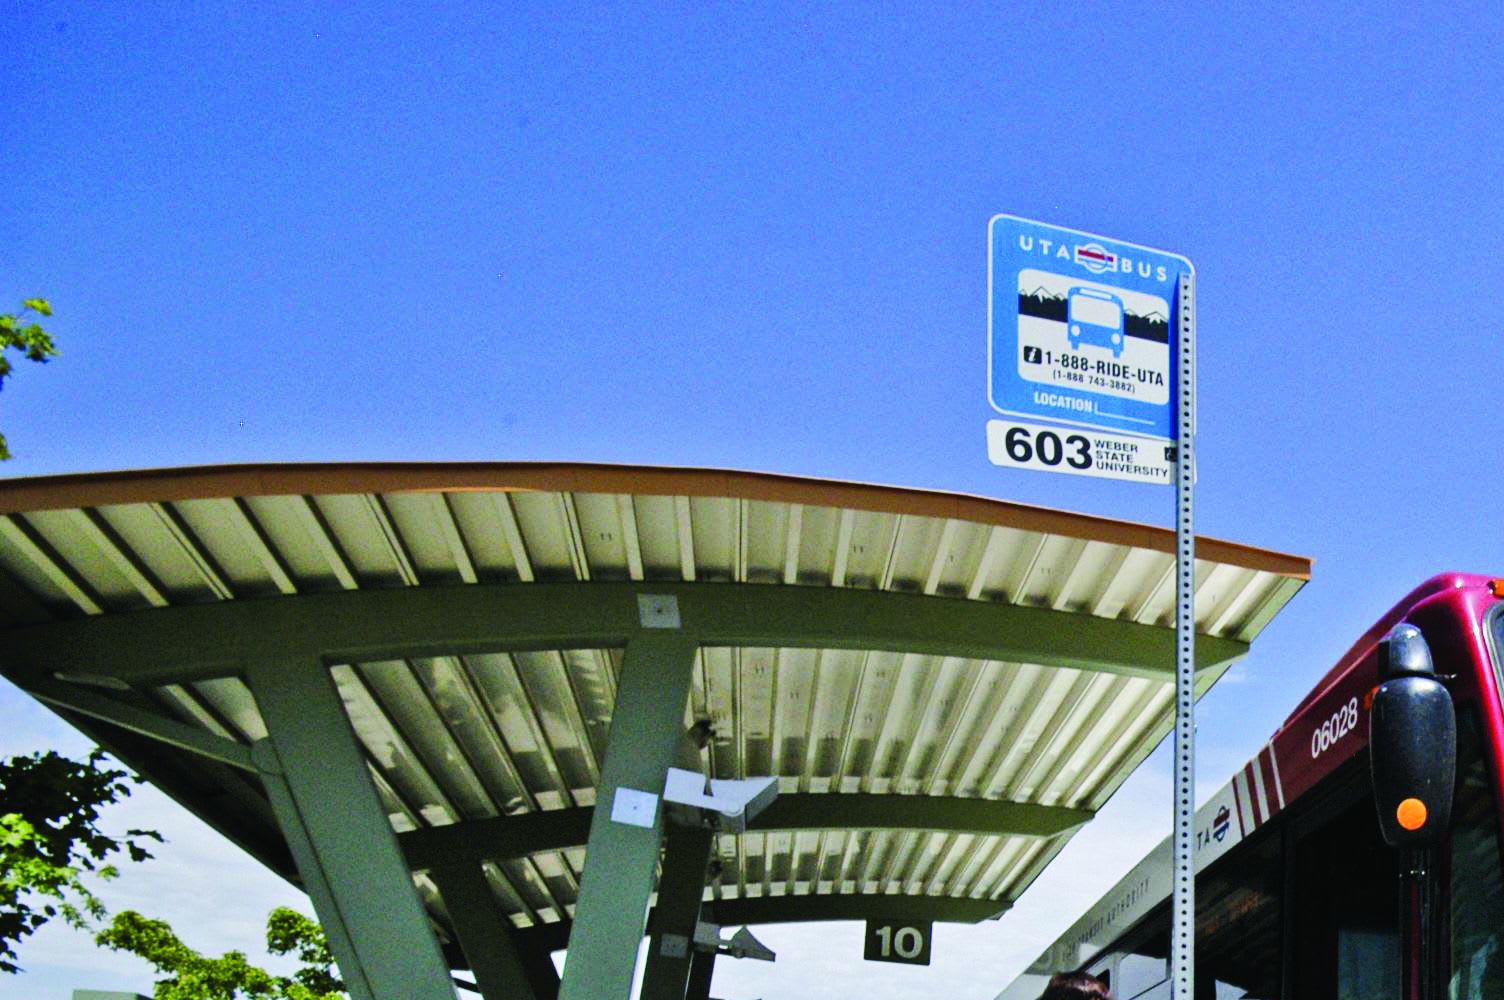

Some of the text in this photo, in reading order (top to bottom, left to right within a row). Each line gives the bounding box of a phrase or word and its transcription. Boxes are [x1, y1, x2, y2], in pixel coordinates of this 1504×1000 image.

[1020, 235, 1167, 281] UTA BUS
[1045, 351, 1164, 387] 1-888-RIDE-UTA
[1034, 391, 1093, 413] LOCATION
[1005, 427, 1093, 470] 603
[1094, 439, 1138, 453] WEBER
[1096, 450, 1133, 463] STATE
[1096, 461, 1168, 477] UNIVERSITY
[1311, 697, 1358, 759] 06028
[876, 926, 923, 959] 10
